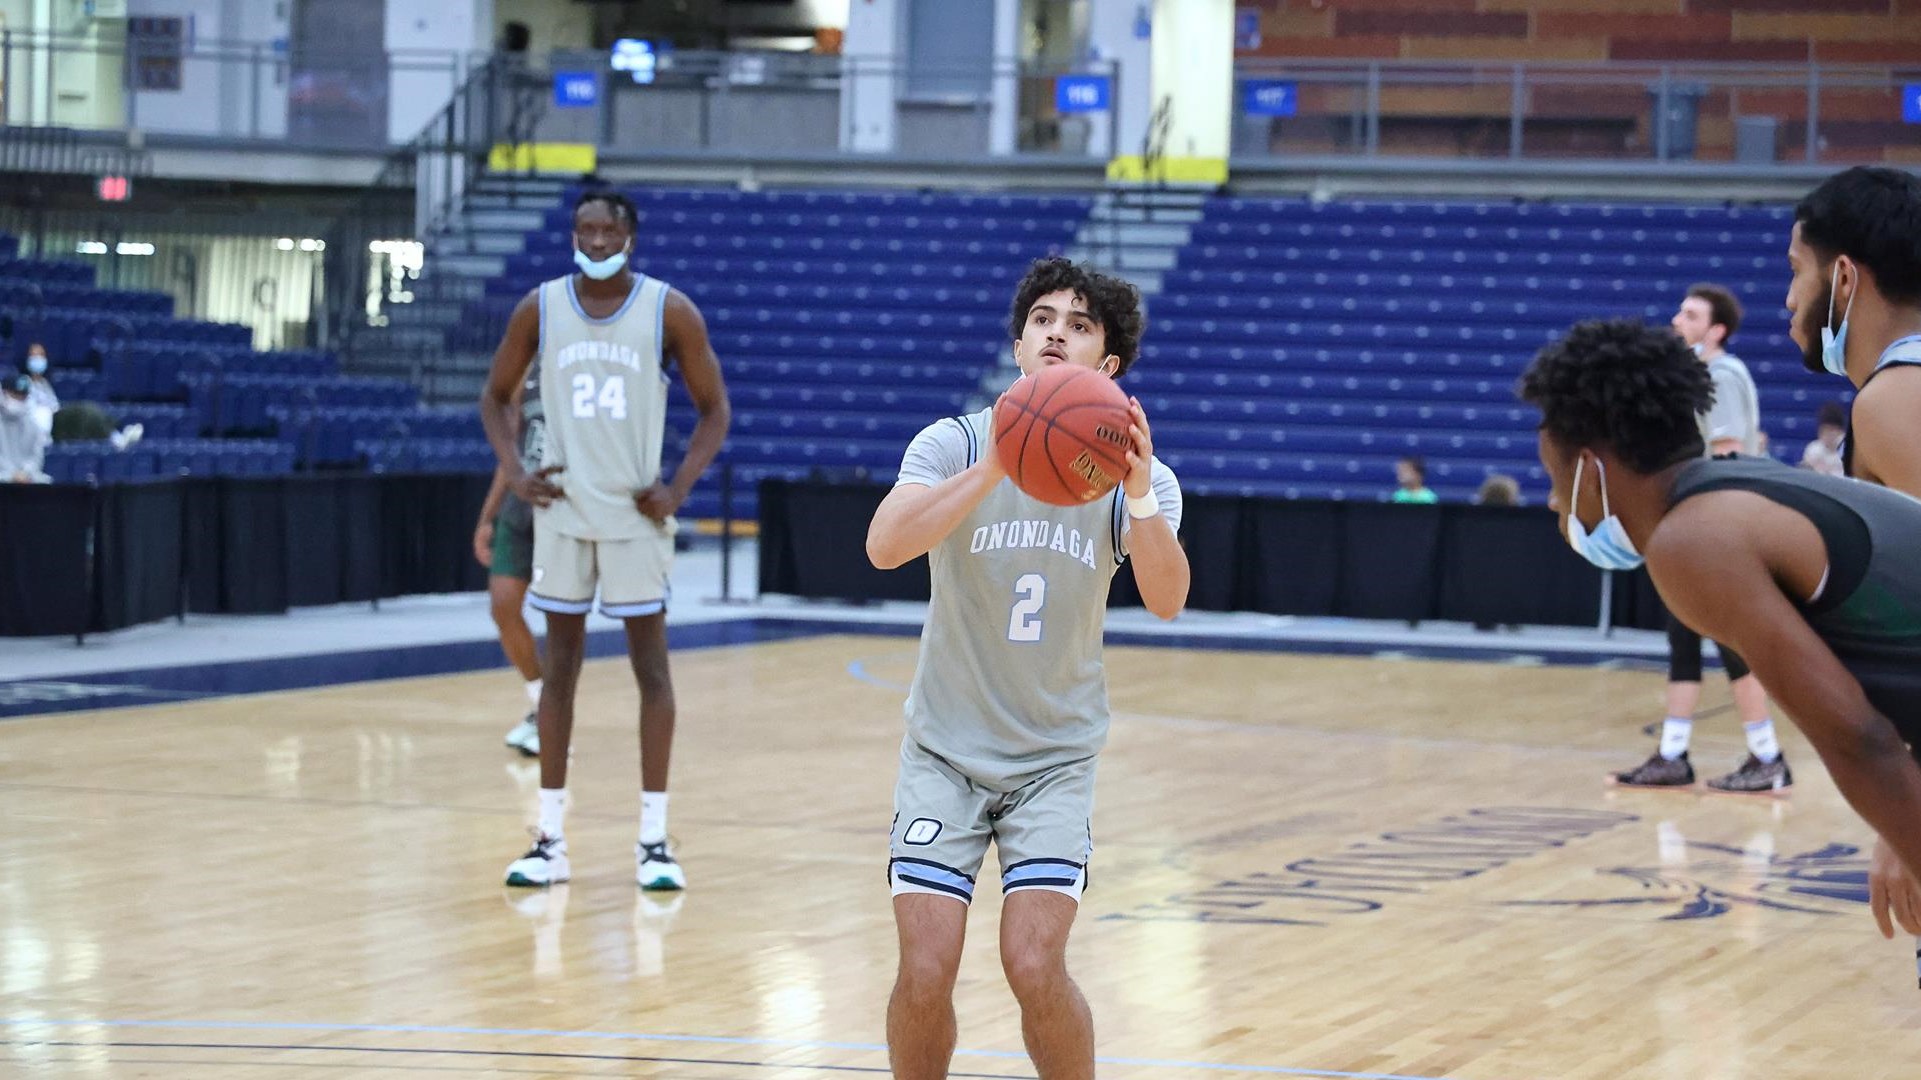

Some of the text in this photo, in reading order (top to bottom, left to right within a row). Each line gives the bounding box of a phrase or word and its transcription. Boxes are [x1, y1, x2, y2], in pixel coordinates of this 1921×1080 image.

[557, 340, 641, 373] ONONDAGA
[571, 372, 627, 420] 24
[969, 519, 1097, 571] ONONDAGA
[1008, 573, 1046, 642] 2
